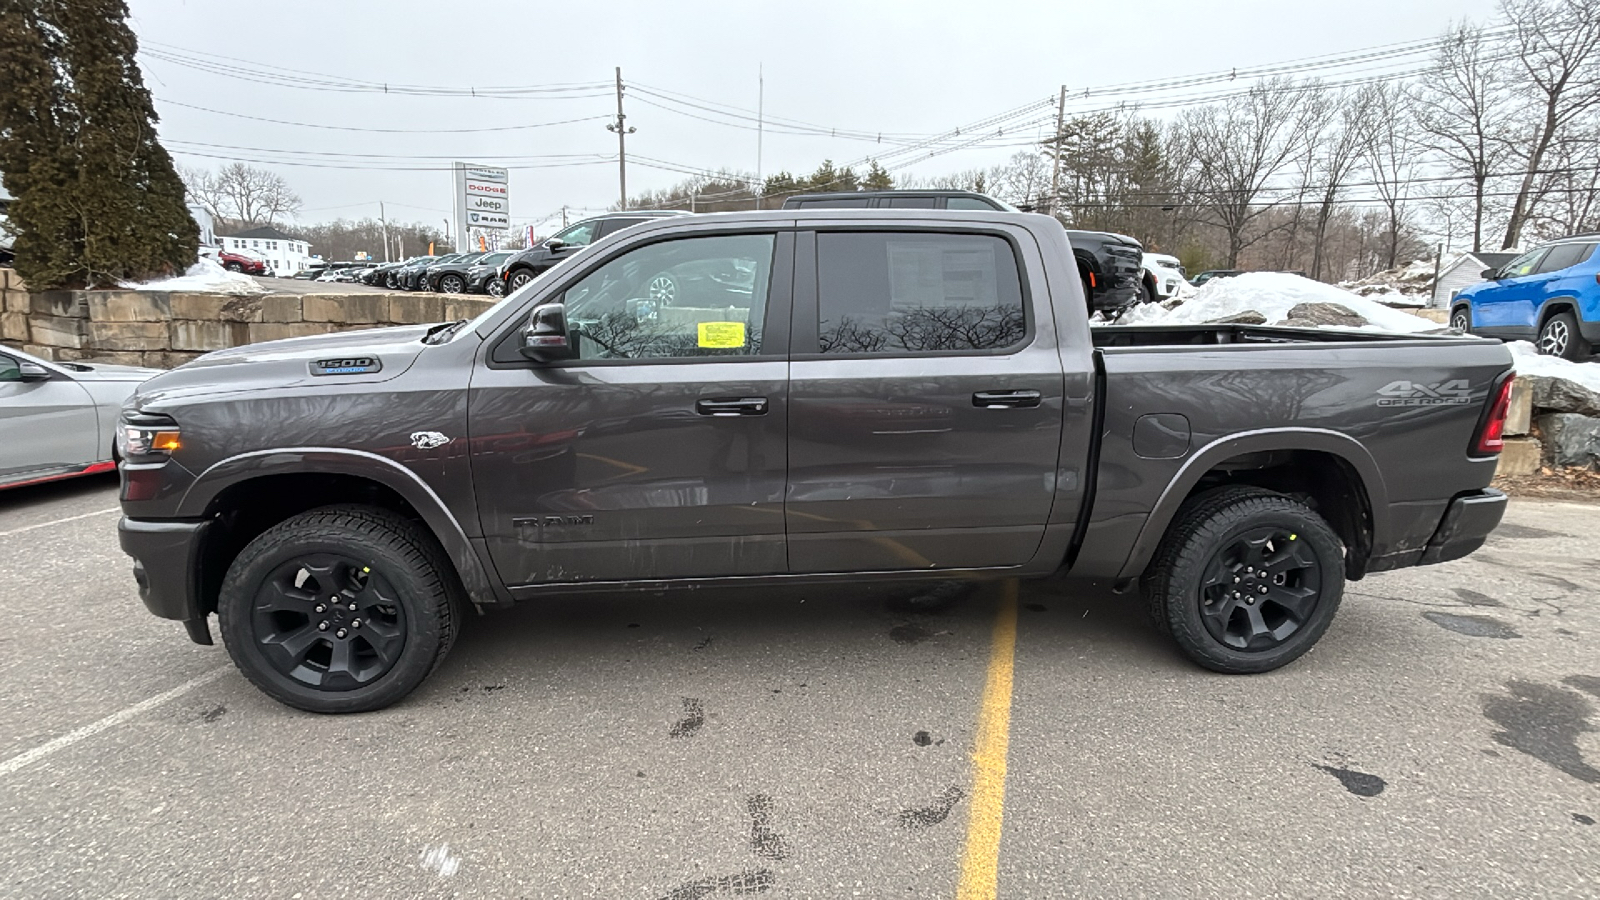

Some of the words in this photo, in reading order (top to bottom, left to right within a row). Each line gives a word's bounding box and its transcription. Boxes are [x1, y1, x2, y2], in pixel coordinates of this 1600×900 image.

[468, 184, 506, 194] DODGE
[475, 198, 502, 210] Jeep
[319, 359, 371, 368] 1500
[1419, 397, 1470, 405] ROAD
[512, 515, 594, 528] RAM
